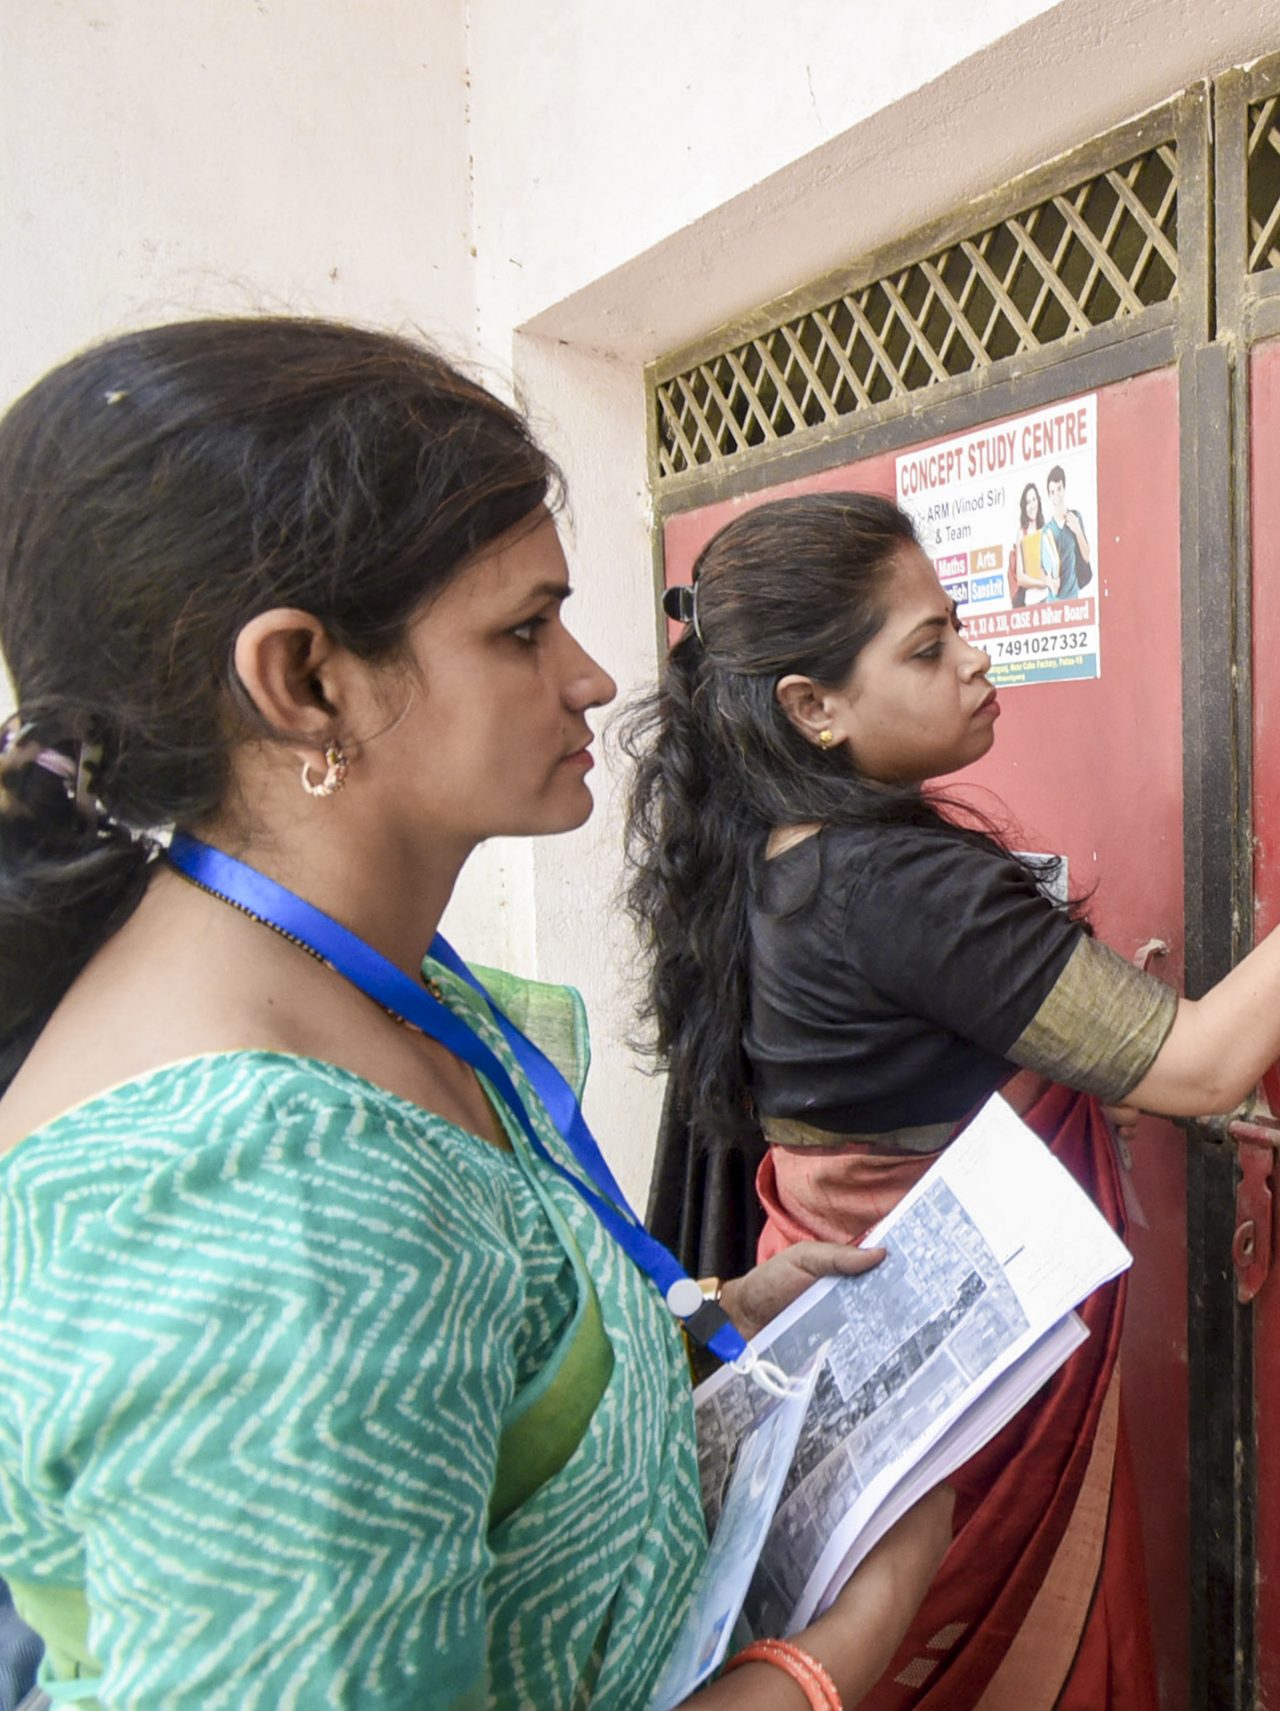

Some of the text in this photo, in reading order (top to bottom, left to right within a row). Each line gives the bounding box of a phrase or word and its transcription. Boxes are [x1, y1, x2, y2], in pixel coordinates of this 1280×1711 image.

[901, 407, 1088, 496] CONCEPT STUDY CENTRE
[952, 493, 984, 520] (Vinod
[987, 488, 1006, 508] Sir)
[935, 524, 972, 544] & Team
[938, 556, 966, 577] Maths
[976, 551, 997, 571] Arts
[972, 577, 1003, 601] Sanskrit
[1010, 611, 1032, 630] CBSE
[1041, 606, 1064, 625] Bihar
[1064, 600, 1090, 622] Board
[996, 632, 1088, 658] 7491027332
